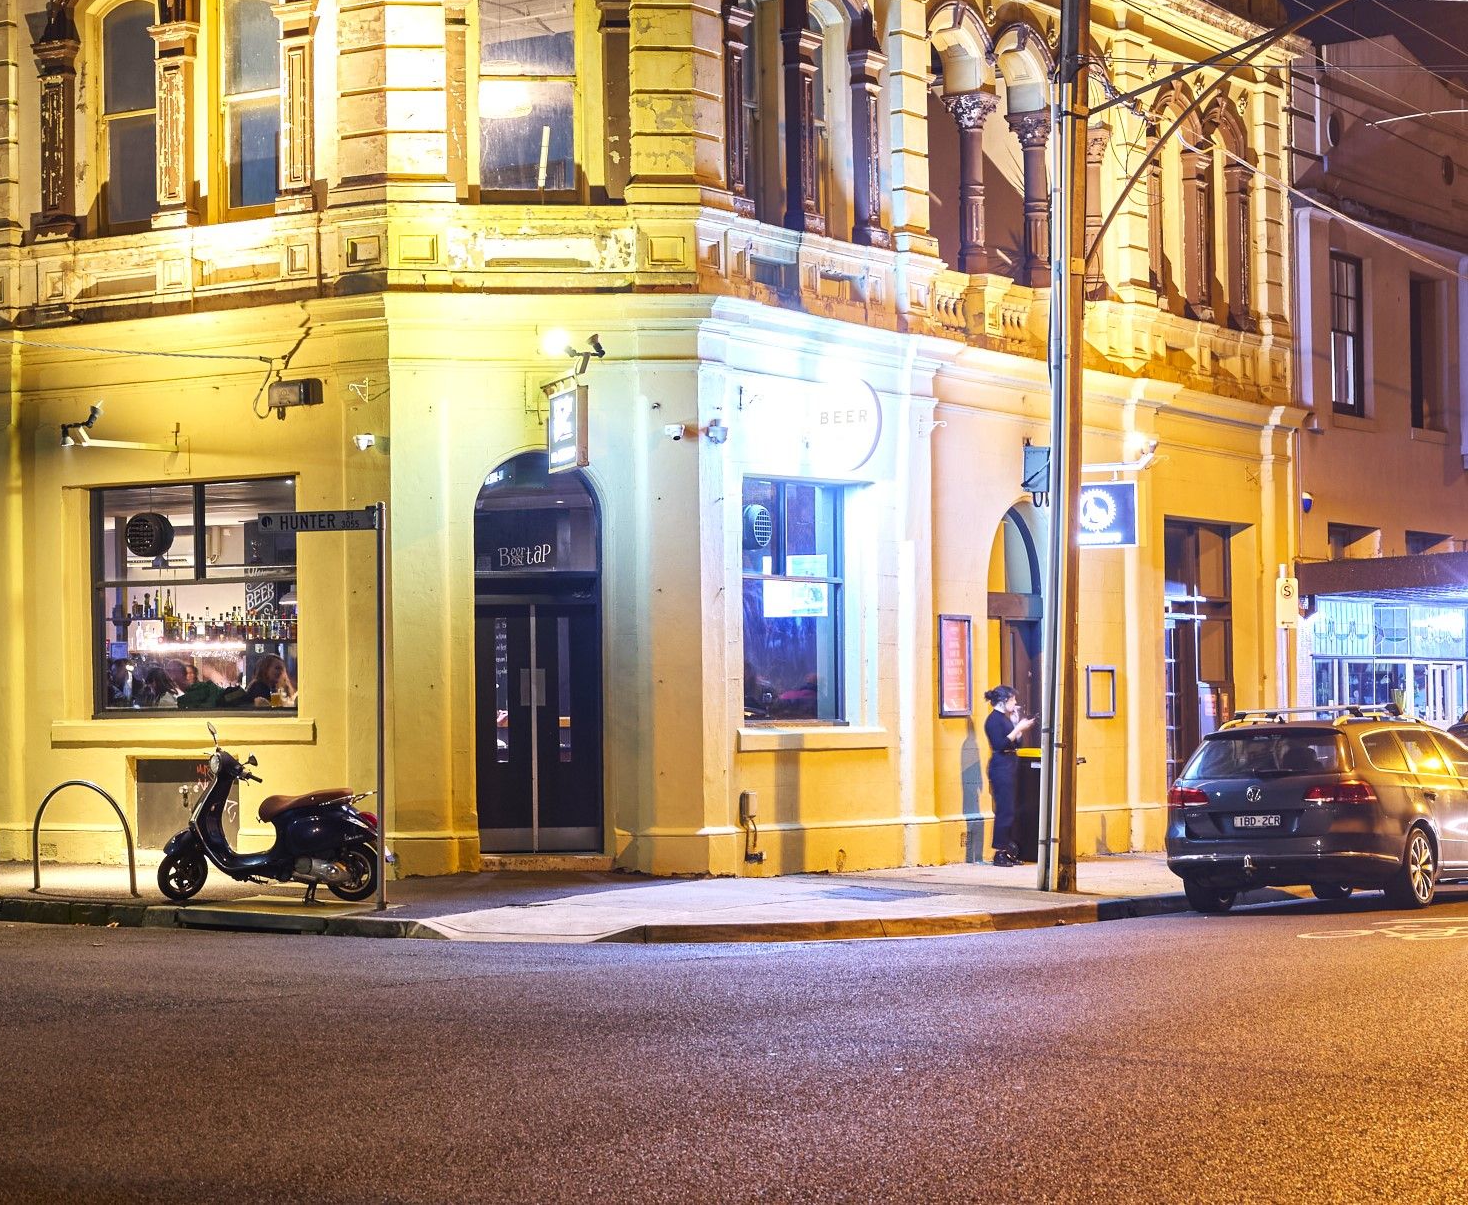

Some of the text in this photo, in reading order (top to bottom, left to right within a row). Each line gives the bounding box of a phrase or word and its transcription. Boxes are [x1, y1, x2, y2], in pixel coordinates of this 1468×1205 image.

[820, 409, 868, 425] BEER
[280, 513, 336, 531] HUNTER
[341, 520, 360, 529] 3055
[246, 582, 275, 611] BEER
